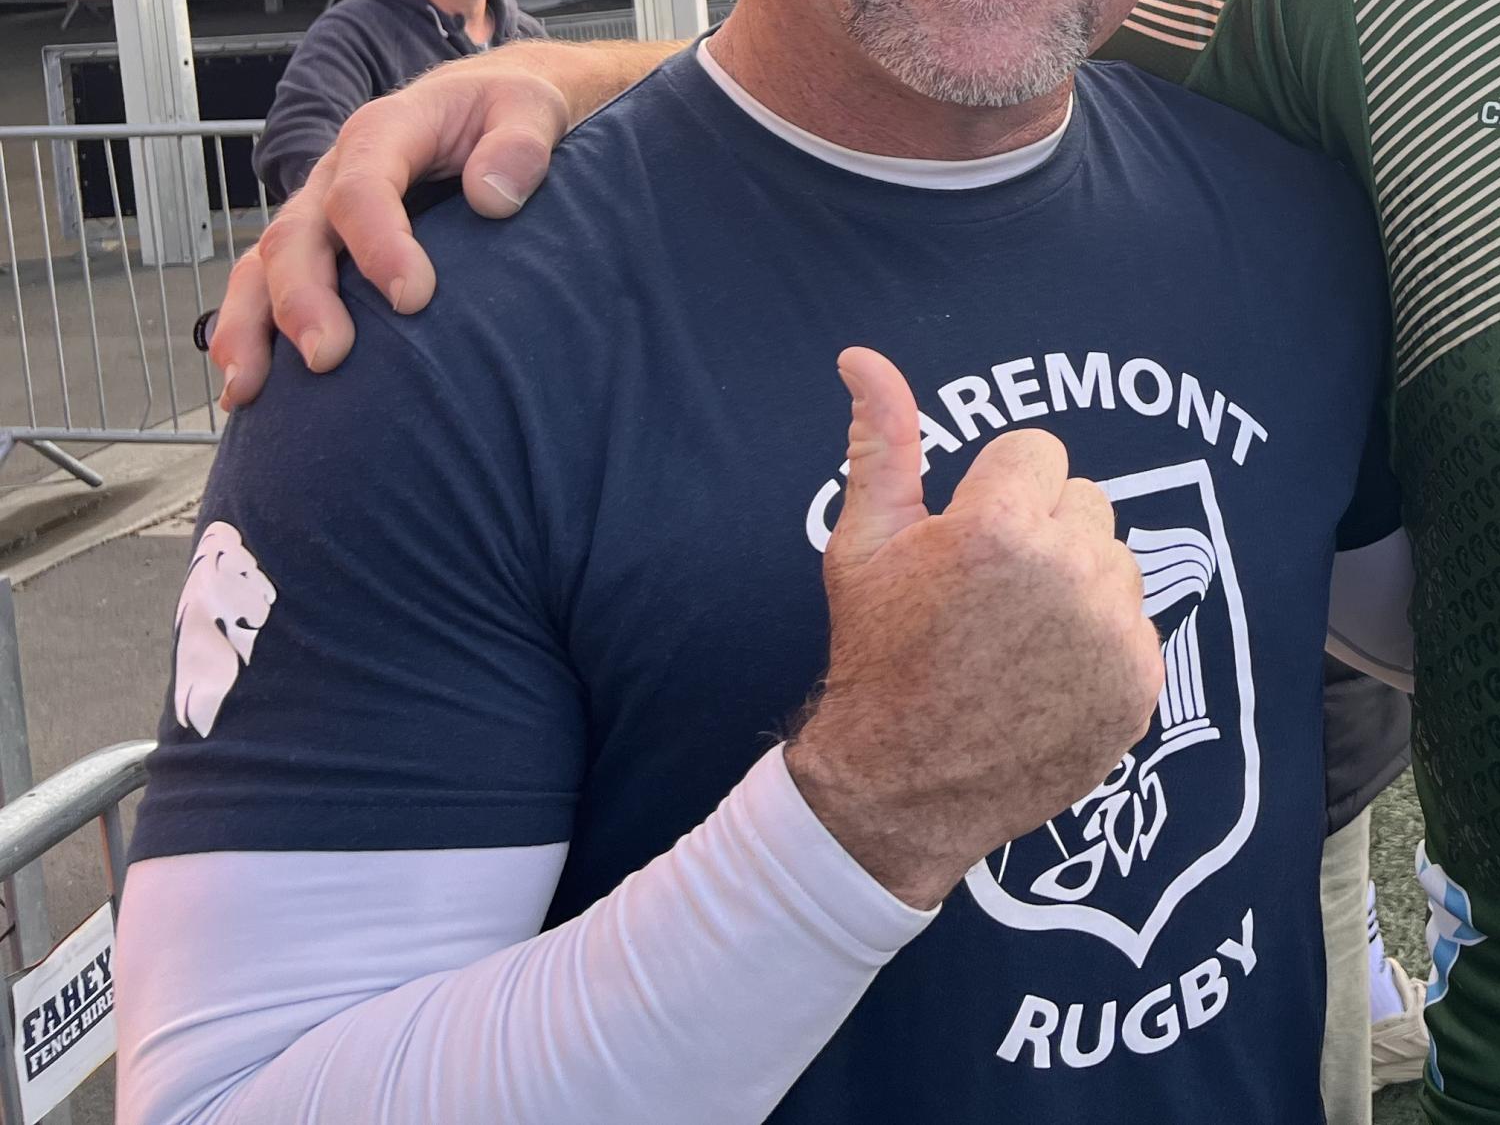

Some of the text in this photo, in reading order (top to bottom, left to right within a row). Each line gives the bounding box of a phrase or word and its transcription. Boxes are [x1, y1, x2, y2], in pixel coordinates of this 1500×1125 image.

[806, 352, 1268, 552] CAREMONT
[23, 946, 112, 1051] FAHEY
[29, 988, 114, 1074] FENCE HIRE
[996, 908, 1257, 1068] RUGBY
